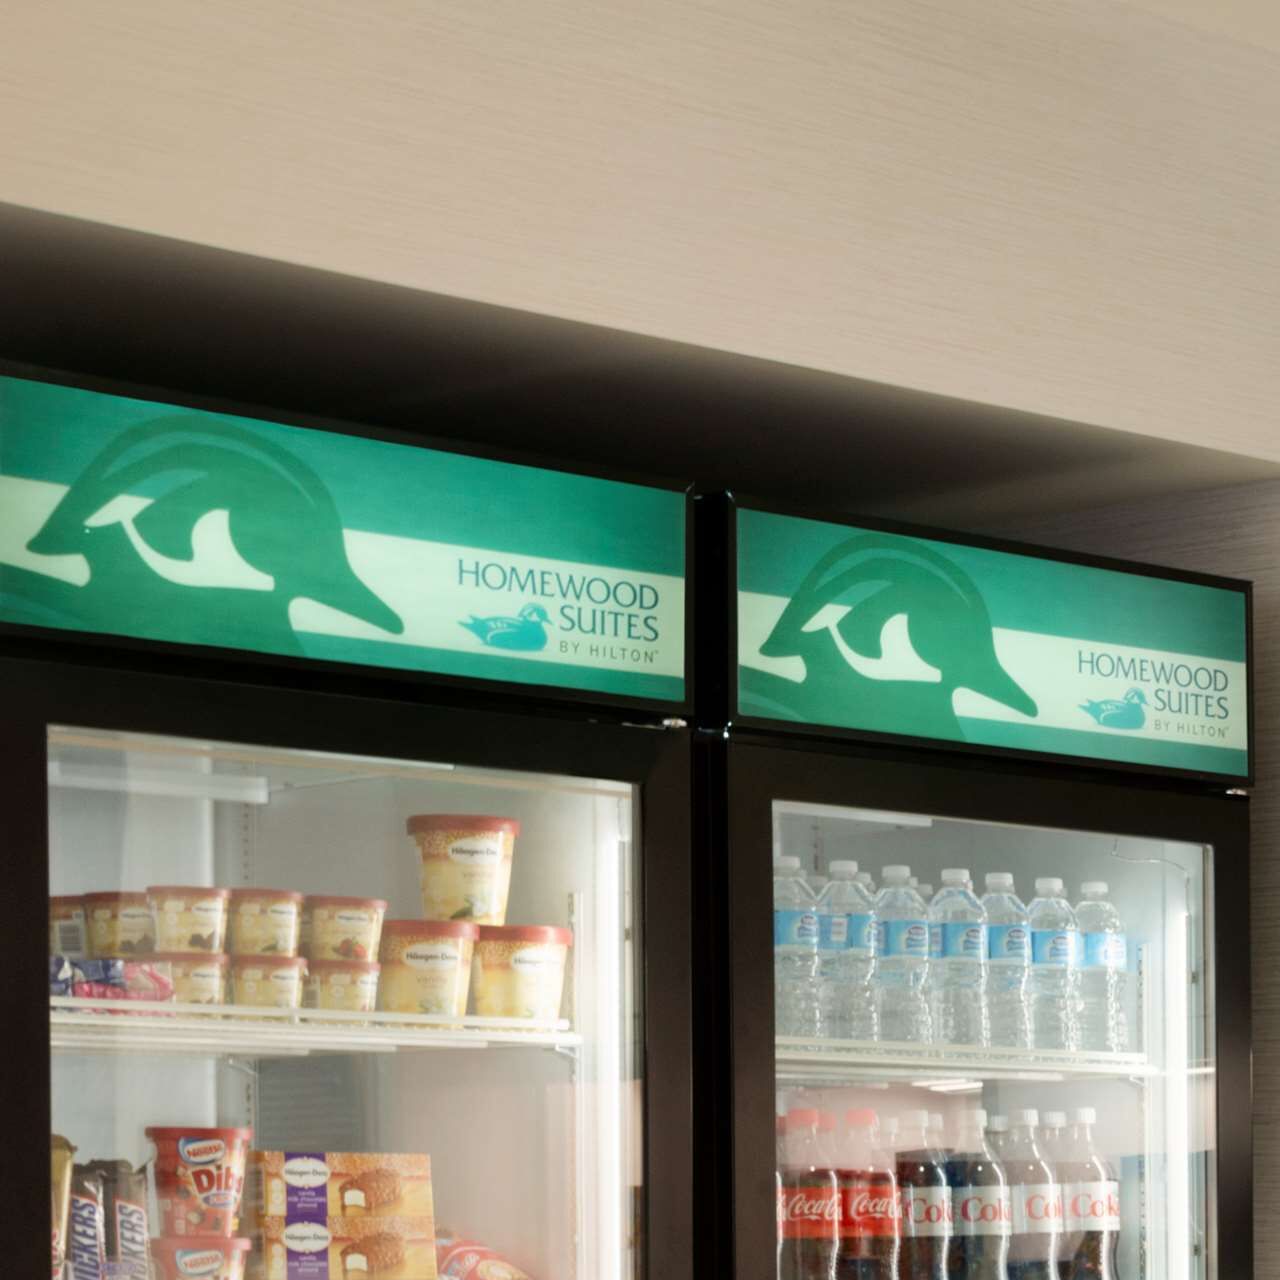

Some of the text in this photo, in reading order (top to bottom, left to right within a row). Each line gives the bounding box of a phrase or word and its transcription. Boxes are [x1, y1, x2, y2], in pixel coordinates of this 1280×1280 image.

[457, 558, 659, 610] HOMEWOOD
[559, 605, 659, 642] SUITES
[559, 641, 654, 664] BY HILTON
[1078, 650, 1229, 692] HOMEWOOD
[1154, 689, 1229, 720] SUITES
[1154, 719, 1226, 739] BY HILTON
[1069, 1193, 1120, 1218] Cok
